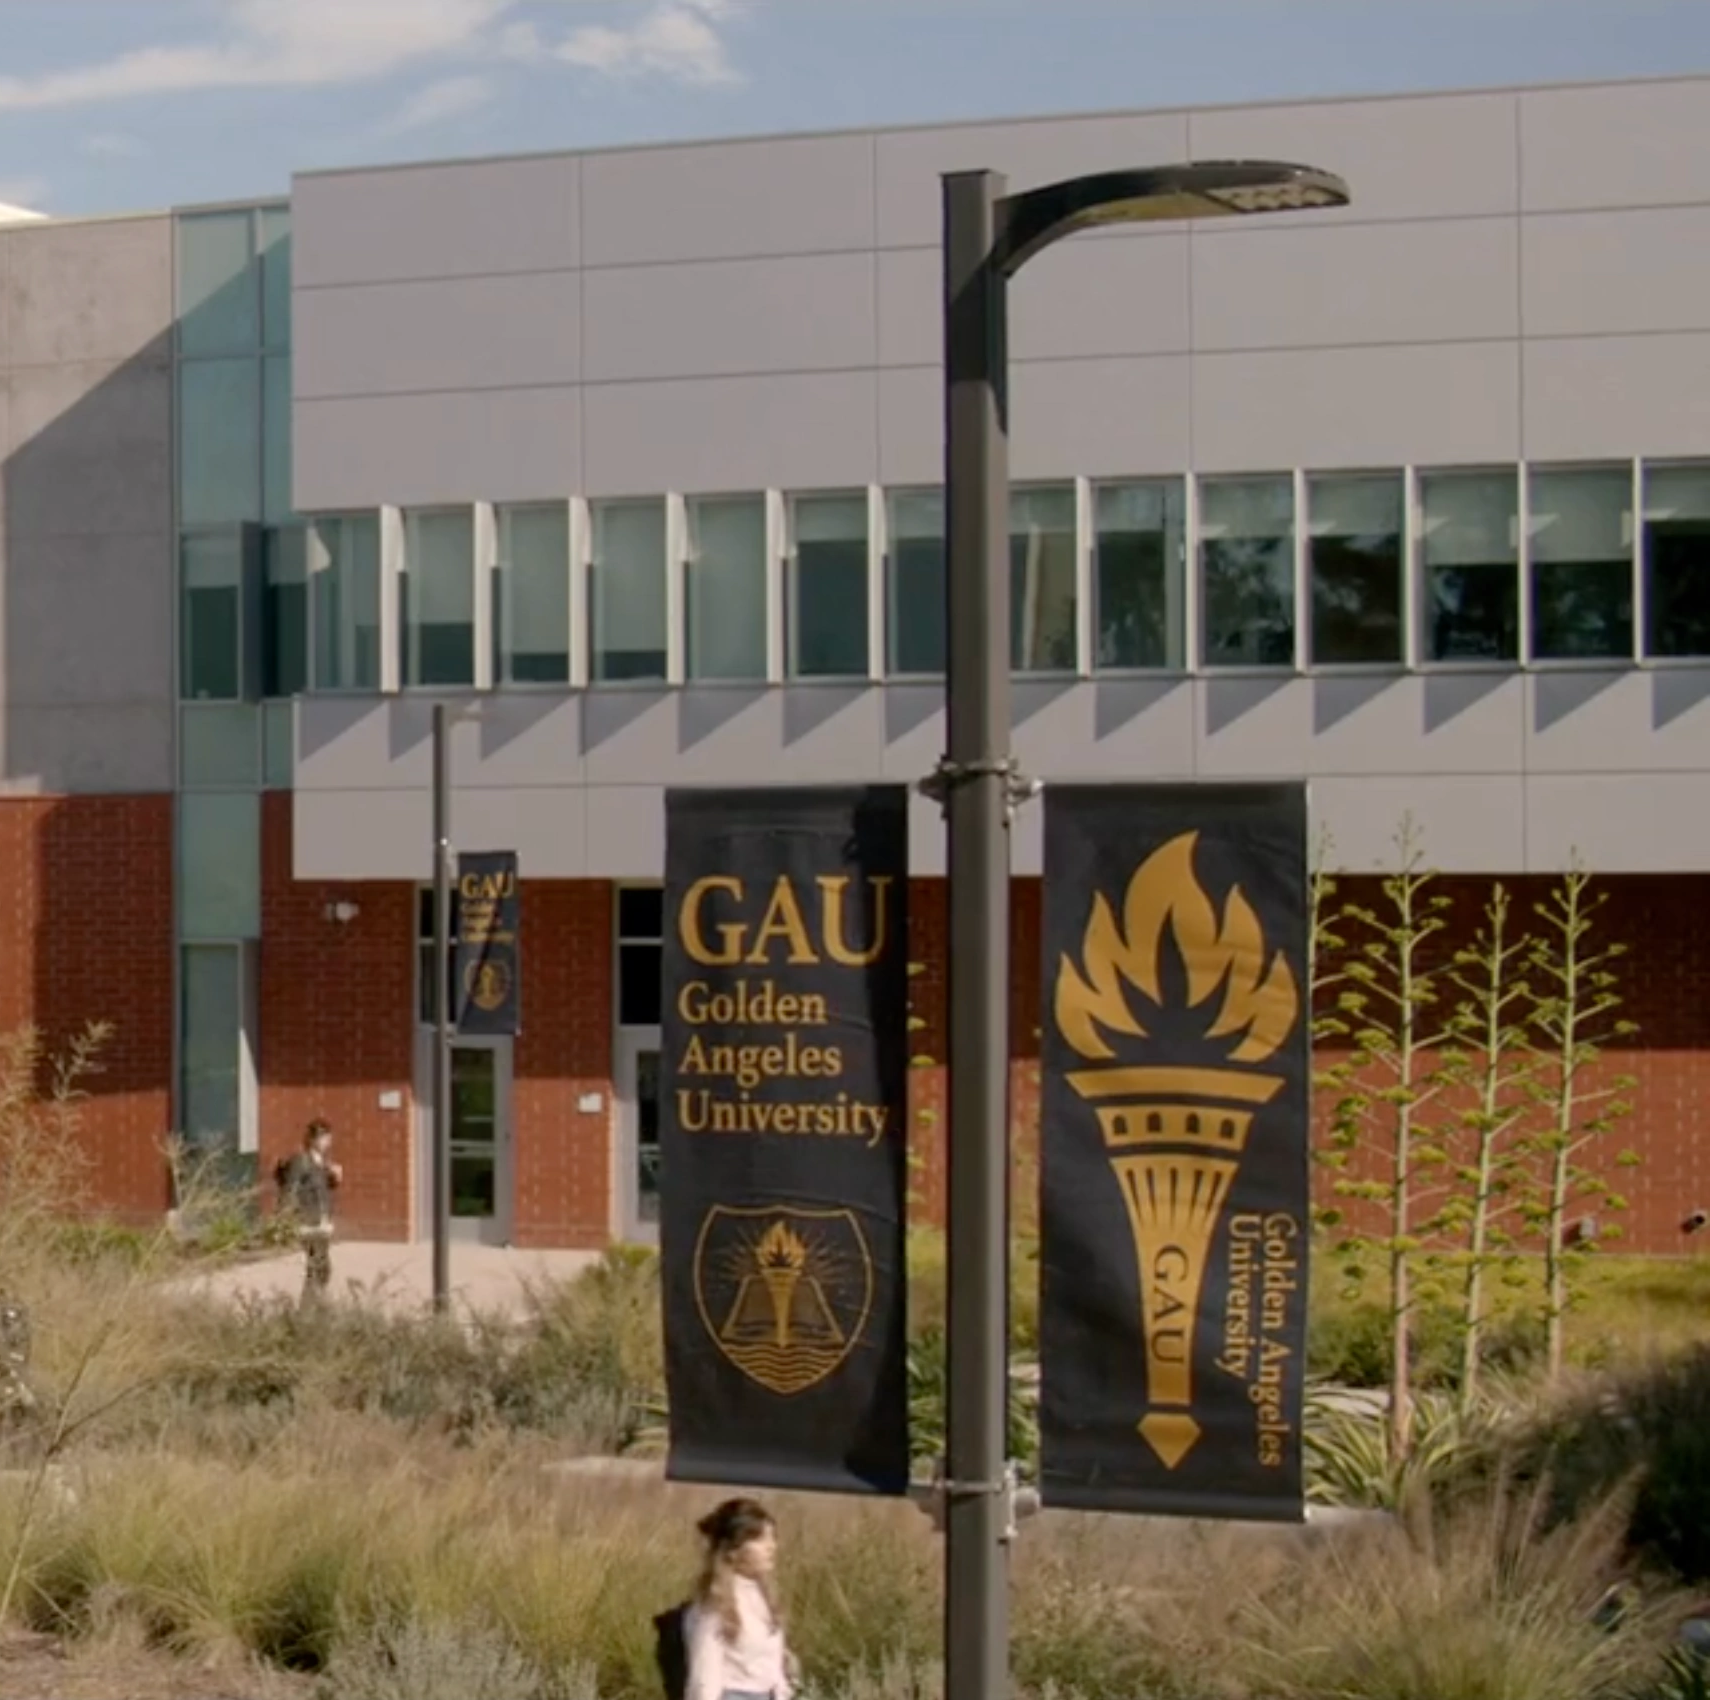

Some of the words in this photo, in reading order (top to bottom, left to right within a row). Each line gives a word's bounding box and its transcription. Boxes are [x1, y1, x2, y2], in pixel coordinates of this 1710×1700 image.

[461, 871, 514, 899] GAU
[678, 874, 893, 967] GAU
[677, 979, 828, 1025] Golden
[677, 1031, 843, 1089] Angeles
[675, 1088, 888, 1148] University
[1150, 1243, 1190, 1366] GAU
[1213, 1213, 1261, 1379] University
[1260, 1211, 1298, 1330] Golden
[1247, 1336, 1291, 1467] Angeles
